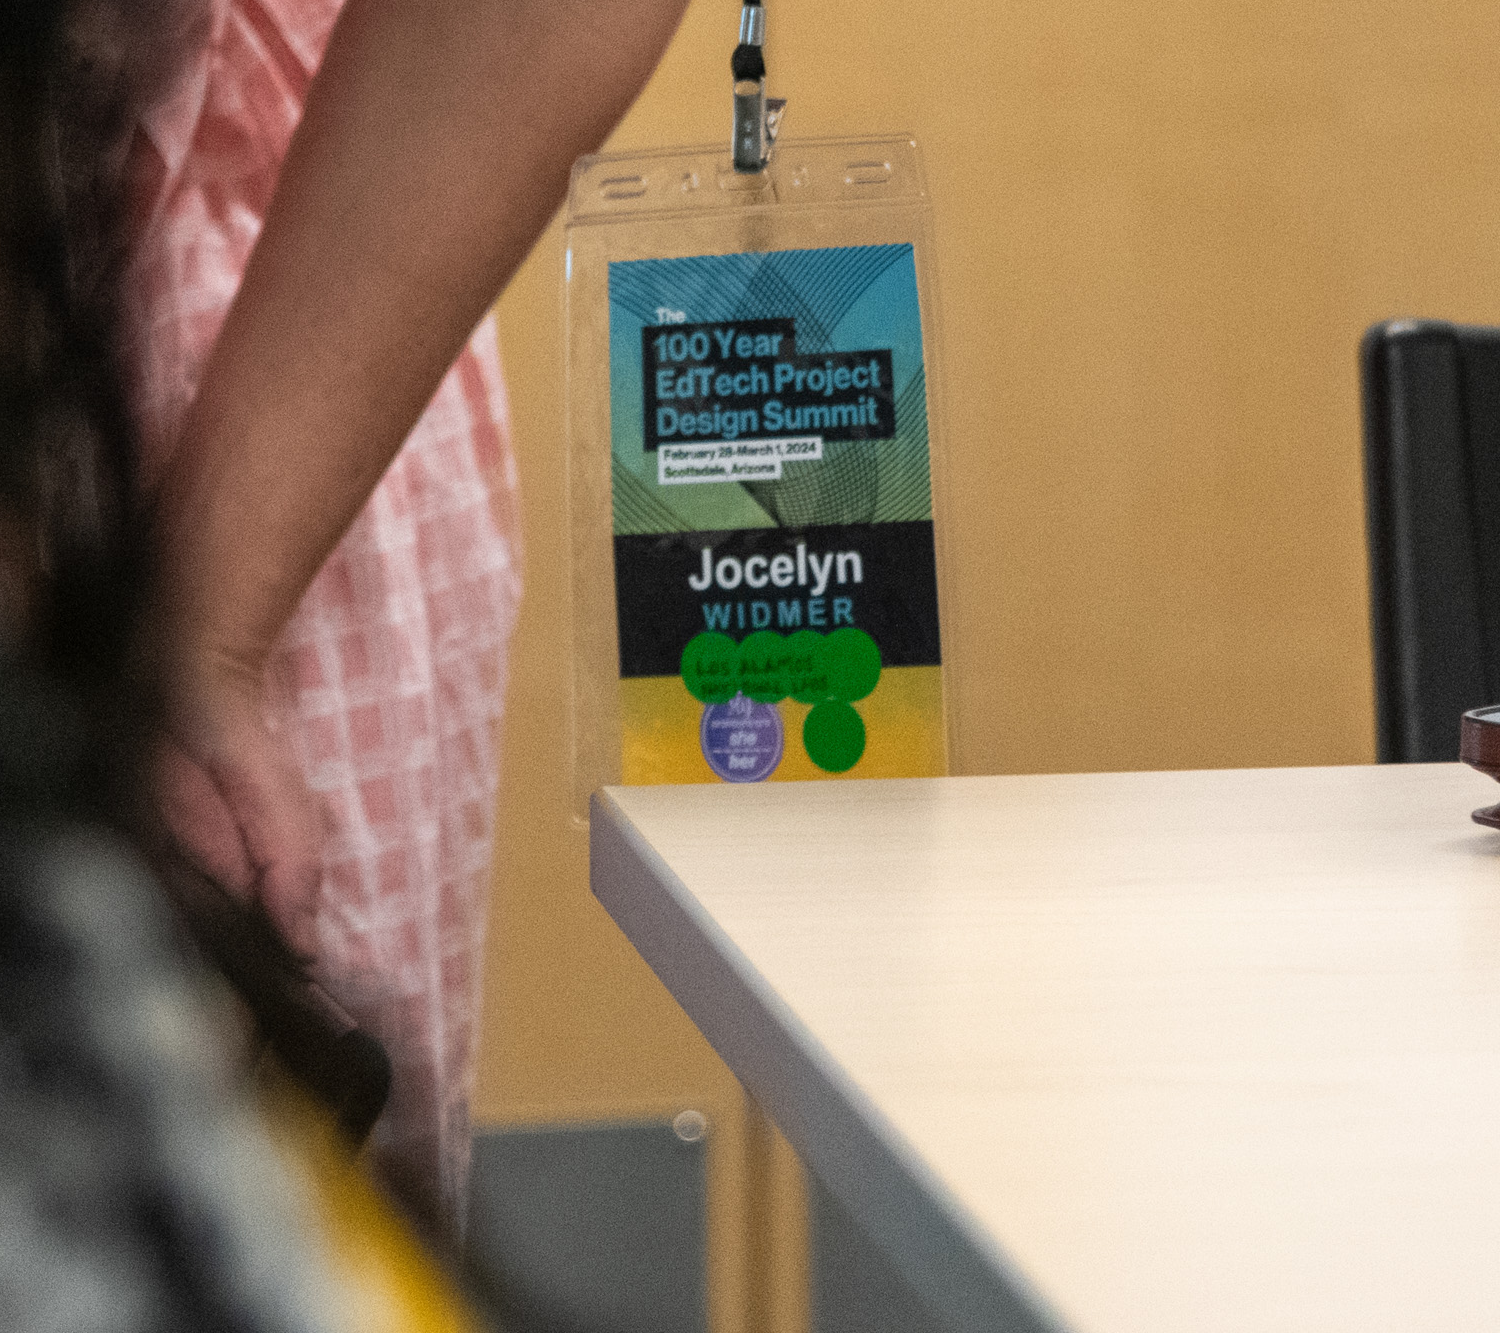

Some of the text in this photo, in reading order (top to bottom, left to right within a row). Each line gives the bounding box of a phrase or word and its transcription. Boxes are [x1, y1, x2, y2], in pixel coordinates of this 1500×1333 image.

[655, 306, 687, 324] The
[654, 328, 784, 363] 100 Year
[655, 358, 881, 400] EdTech Project
[655, 394, 880, 439] Design Summit
[663, 446, 716, 462] February
[785, 441, 818, 455] 2024
[730, 461, 776, 476] Arizona
[687, 542, 864, 597] Jocelyn
[701, 595, 855, 630] WIDMER
[728, 753, 758, 770] her
